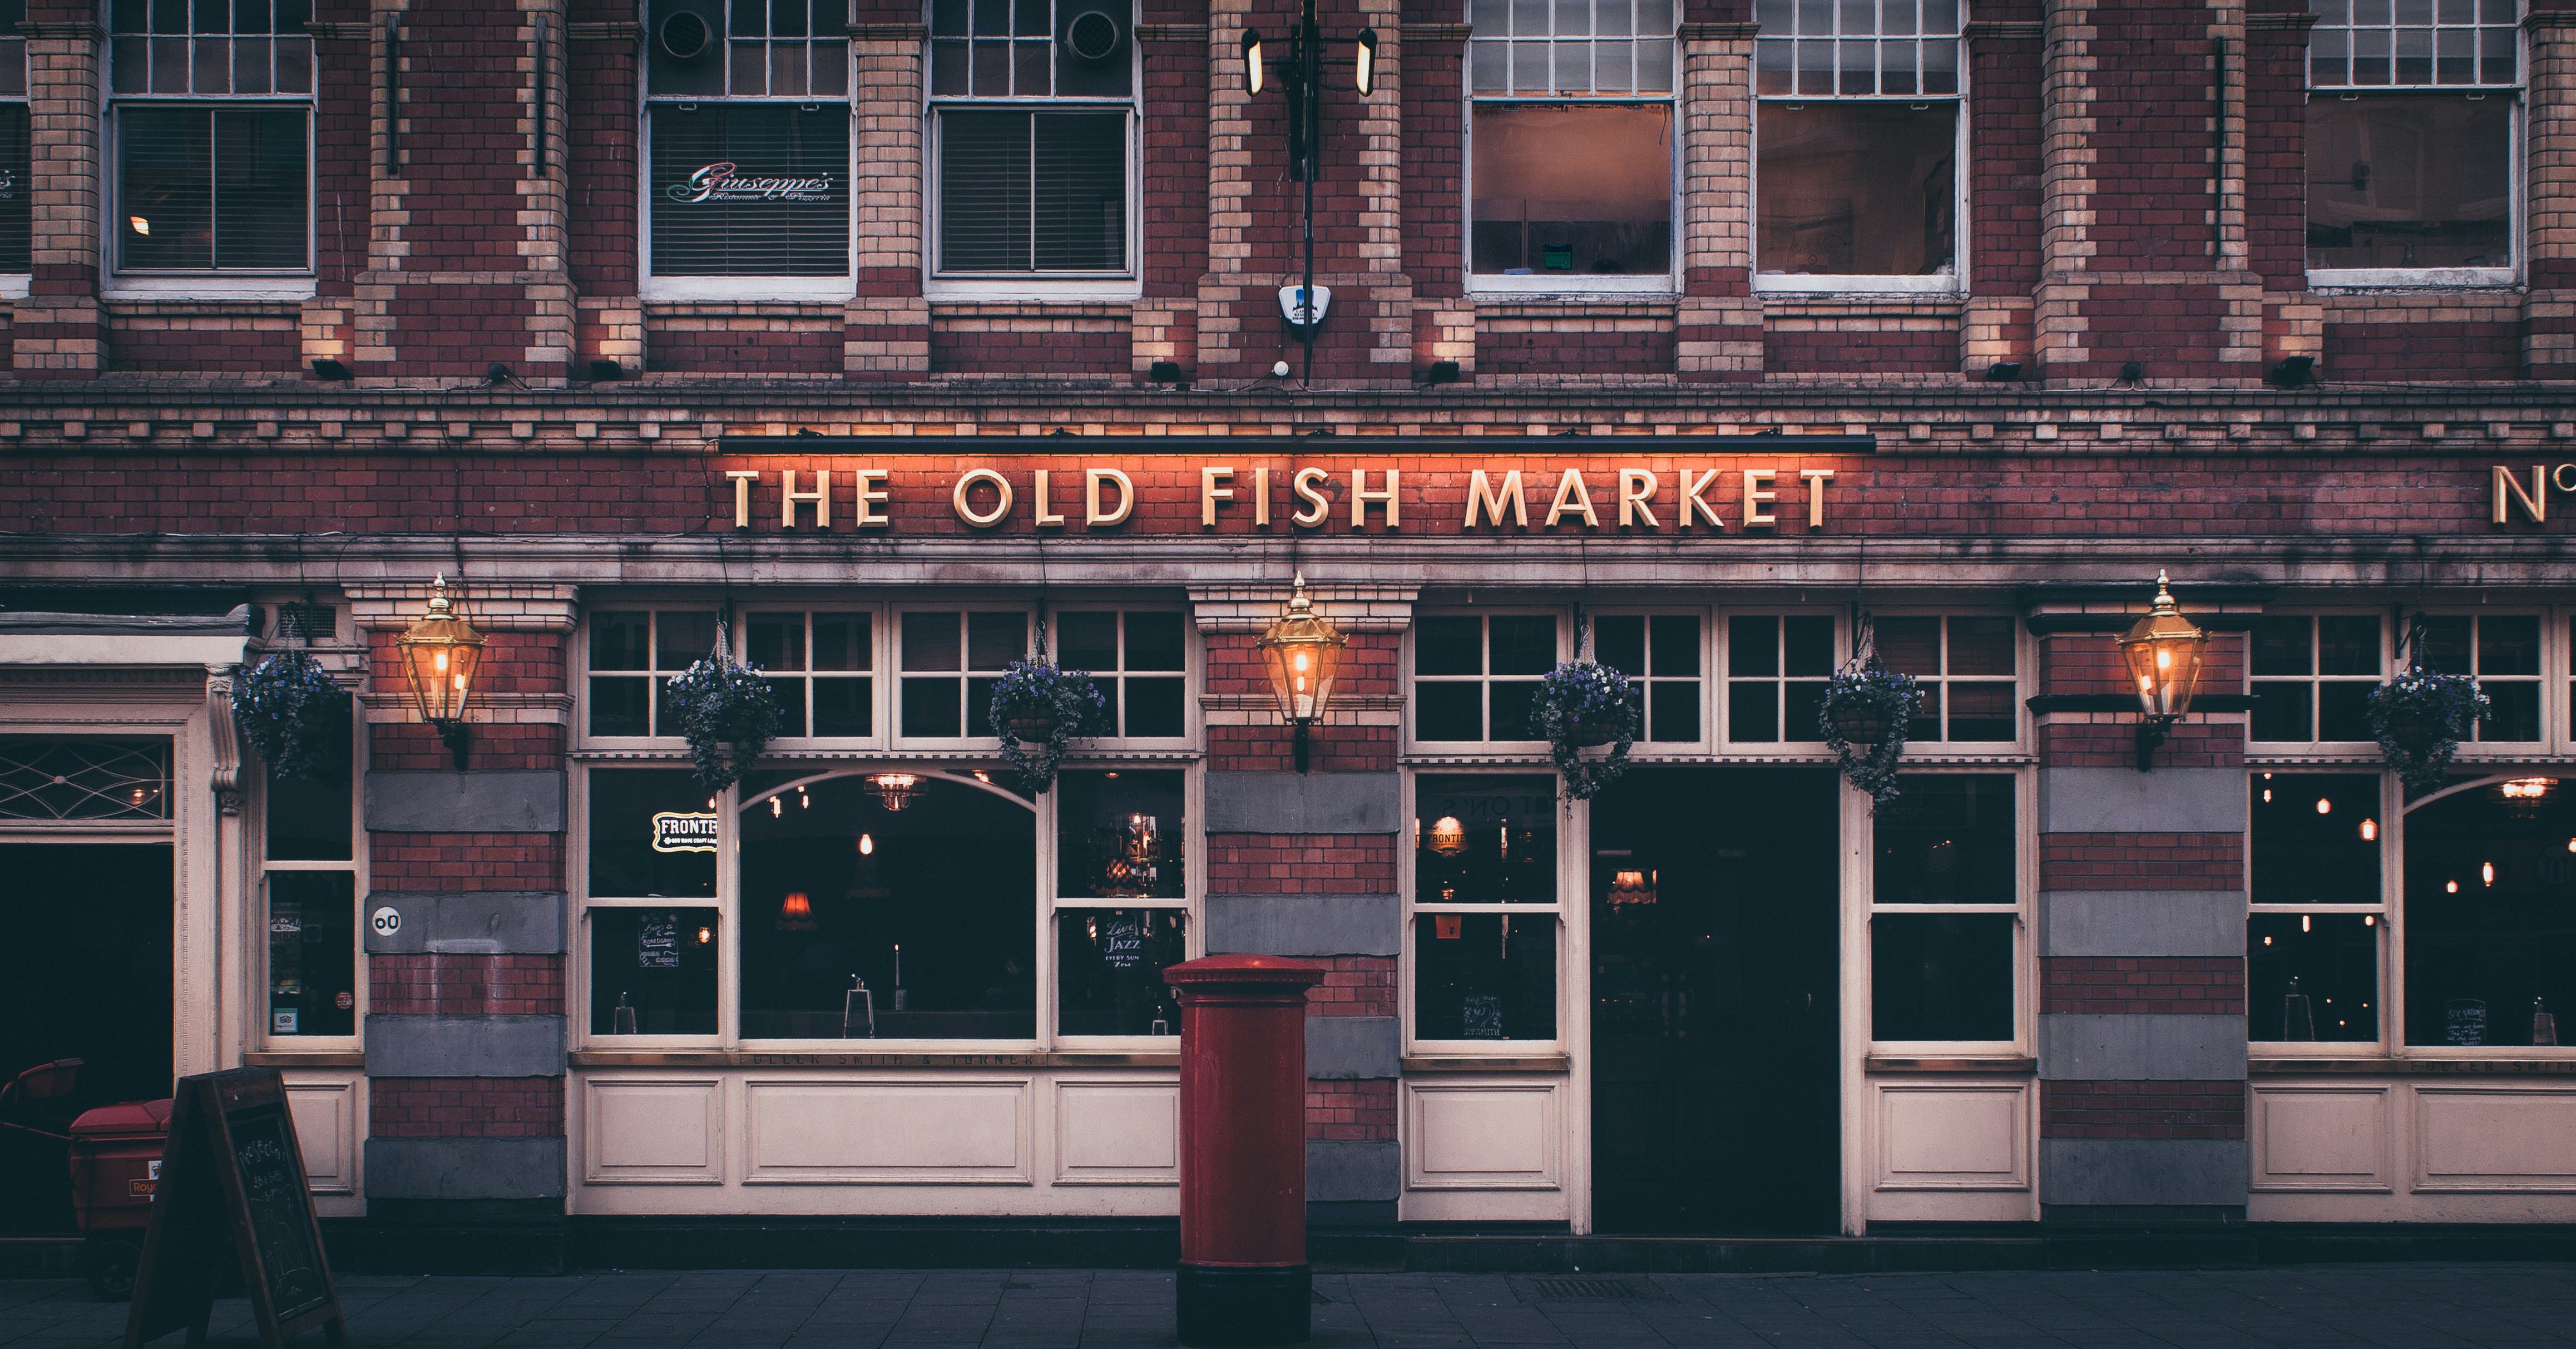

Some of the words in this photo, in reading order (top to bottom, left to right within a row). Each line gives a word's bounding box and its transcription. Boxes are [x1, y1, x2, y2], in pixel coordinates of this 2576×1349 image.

[666, 162, 834, 202] Giuseppe's
[725, 468, 889, 528] THE
[953, 467, 1134, 528] OLD
[1202, 466, 1400, 528] FISH
[1463, 467, 1835, 528] MARKET
[1107, 921, 1134, 935] Live
[2447, 1009, 2461, 1020] SIX
[740, 1054, 820, 1065] FULLER
[839, 1054, 903, 1065] SMITH
[922, 1055, 931, 1065] &
[951, 1054, 1034, 1065] TURNER
